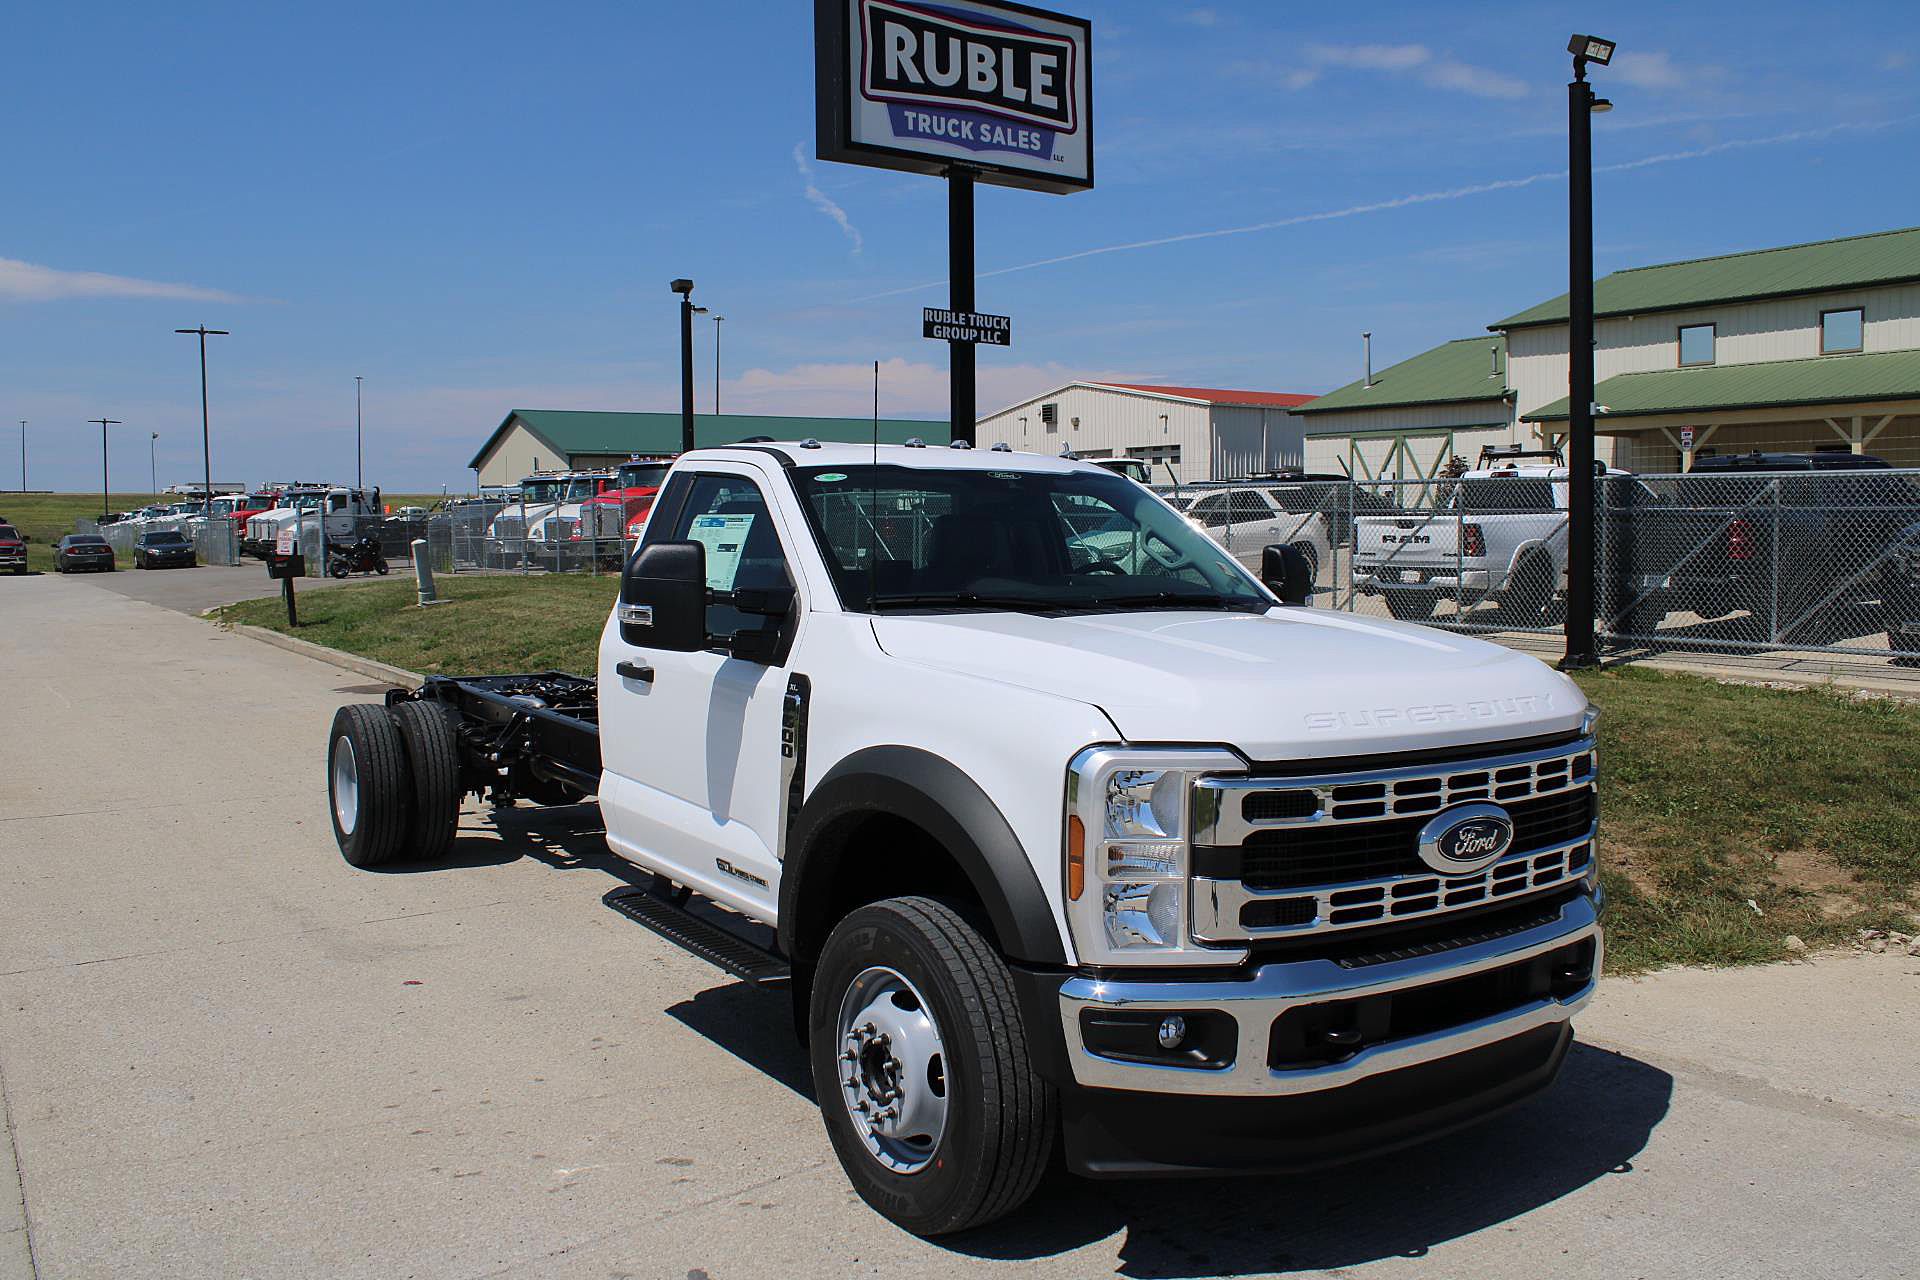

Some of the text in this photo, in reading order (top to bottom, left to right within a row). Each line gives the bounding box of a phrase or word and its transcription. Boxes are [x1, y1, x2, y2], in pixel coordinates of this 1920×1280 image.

[884, 20, 1058, 110] RUBLE
[904, 111, 1041, 151] TRUCK SALES
[1053, 153, 1065, 163] LLC
[924, 309, 1009, 330] RUBLE TRUCK
[933, 325, 1001, 343] GROUP LLC
[1382, 535, 1430, 544] RAM
[1303, 693, 1553, 733] SUPER DUTY
[1454, 826, 1498, 856] Ford
